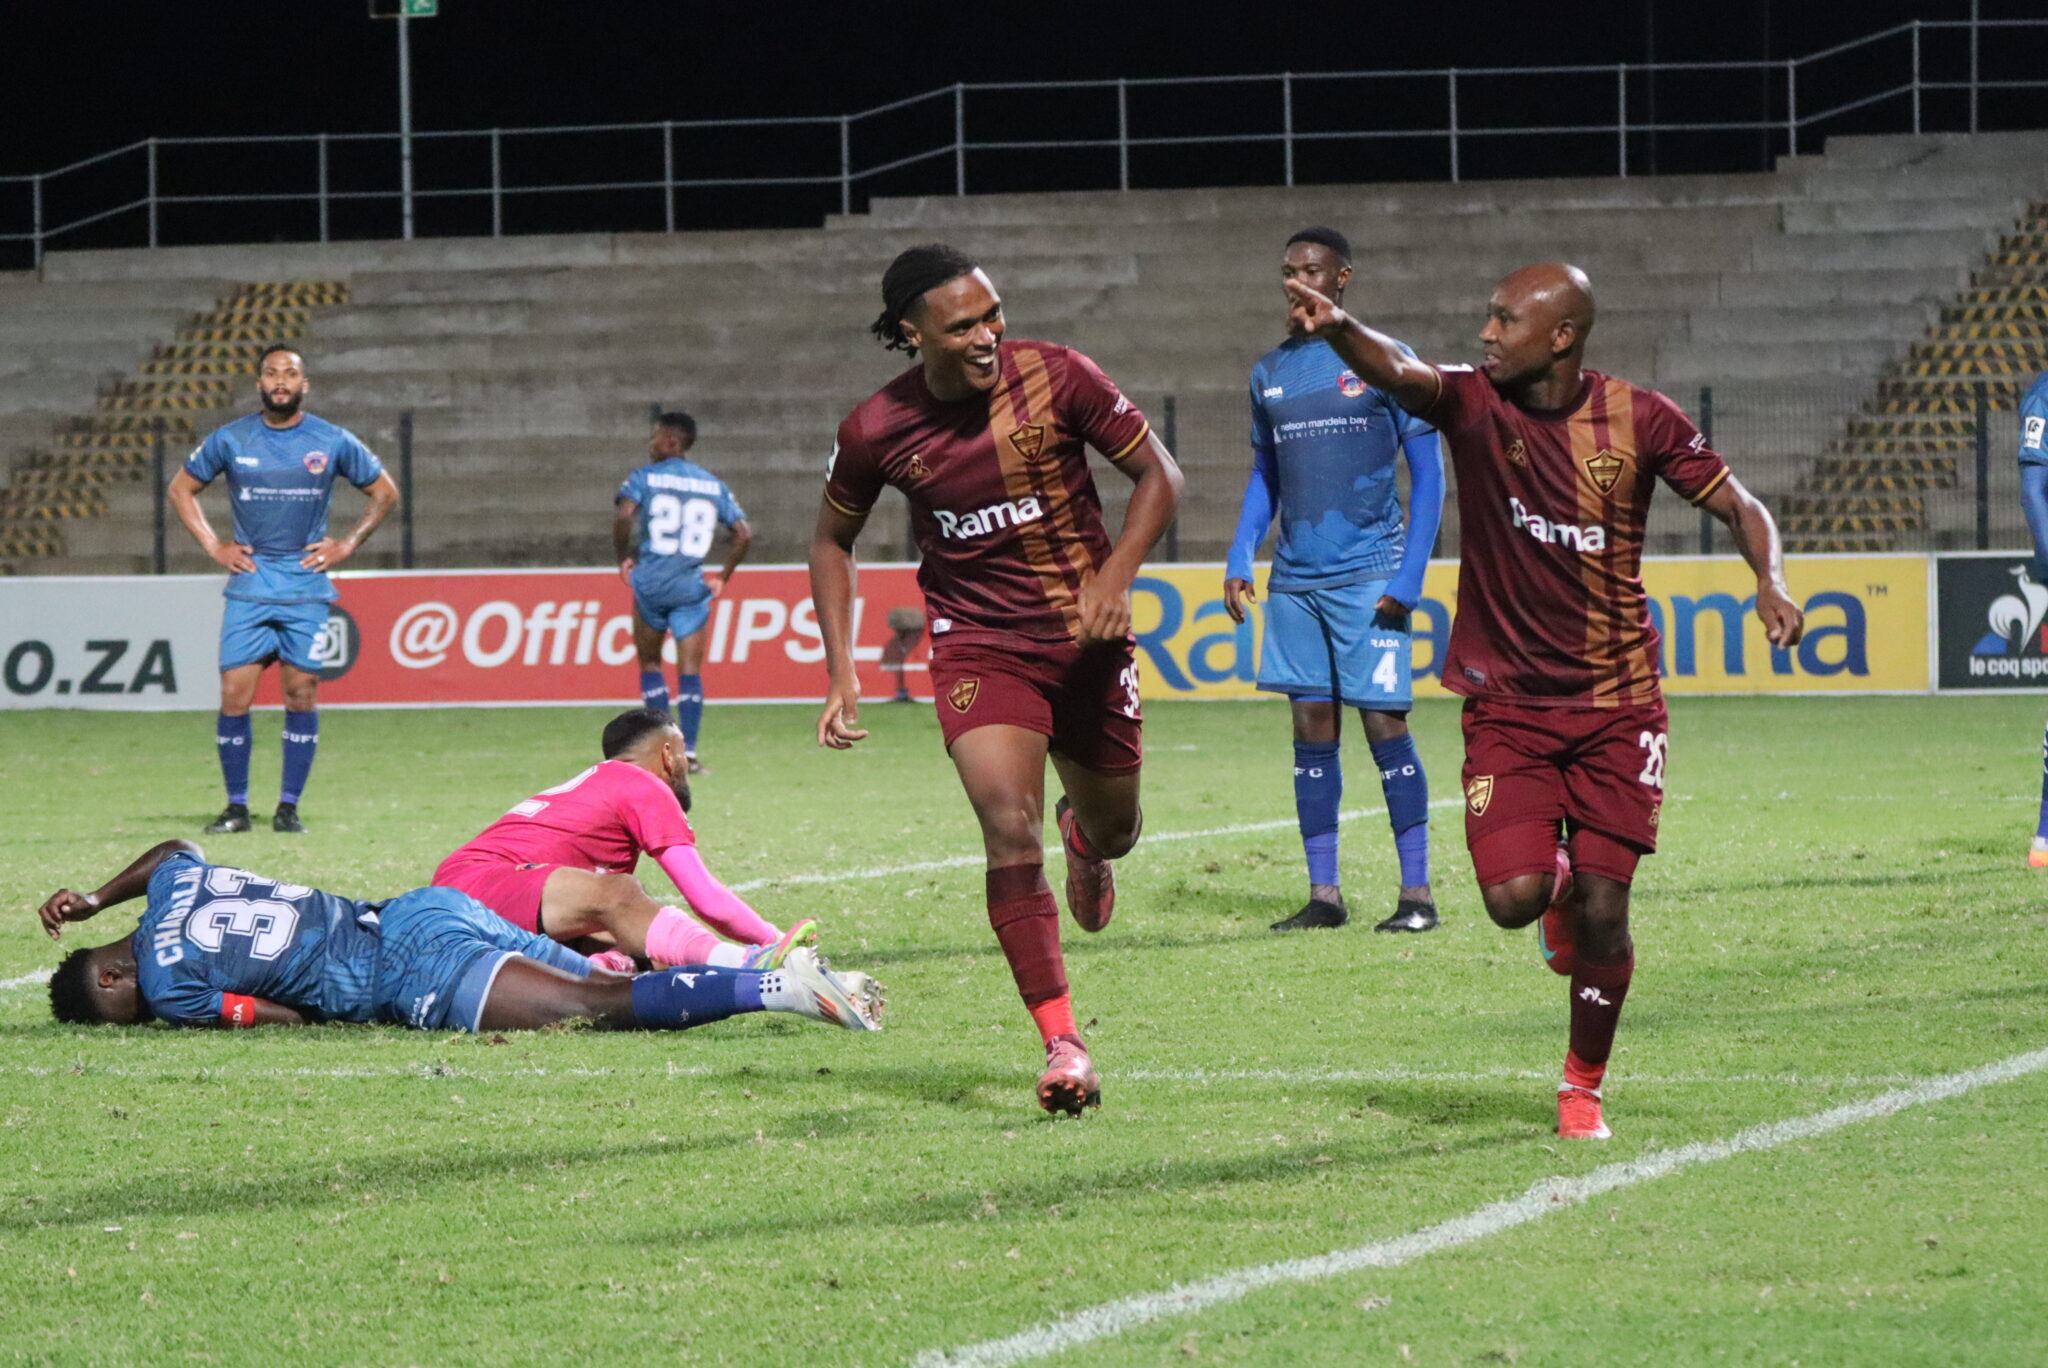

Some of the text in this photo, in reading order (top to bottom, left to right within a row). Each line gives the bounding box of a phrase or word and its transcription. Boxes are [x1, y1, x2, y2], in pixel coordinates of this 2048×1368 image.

[1281, 416, 1367, 431] nelson mandela bay
[648, 493, 718, 558] 28
[933, 496, 1044, 539] Rama
[1509, 497, 1605, 552] Rama
[1130, 577, 1451, 691] Raa
[1370, 639, 1400, 649] RADA
[1372, 651, 1398, 693] 4
[1969, 656, 1986, 676] le
[1988, 657, 2020, 679] coq
[1639, 731, 1668, 788] 20
